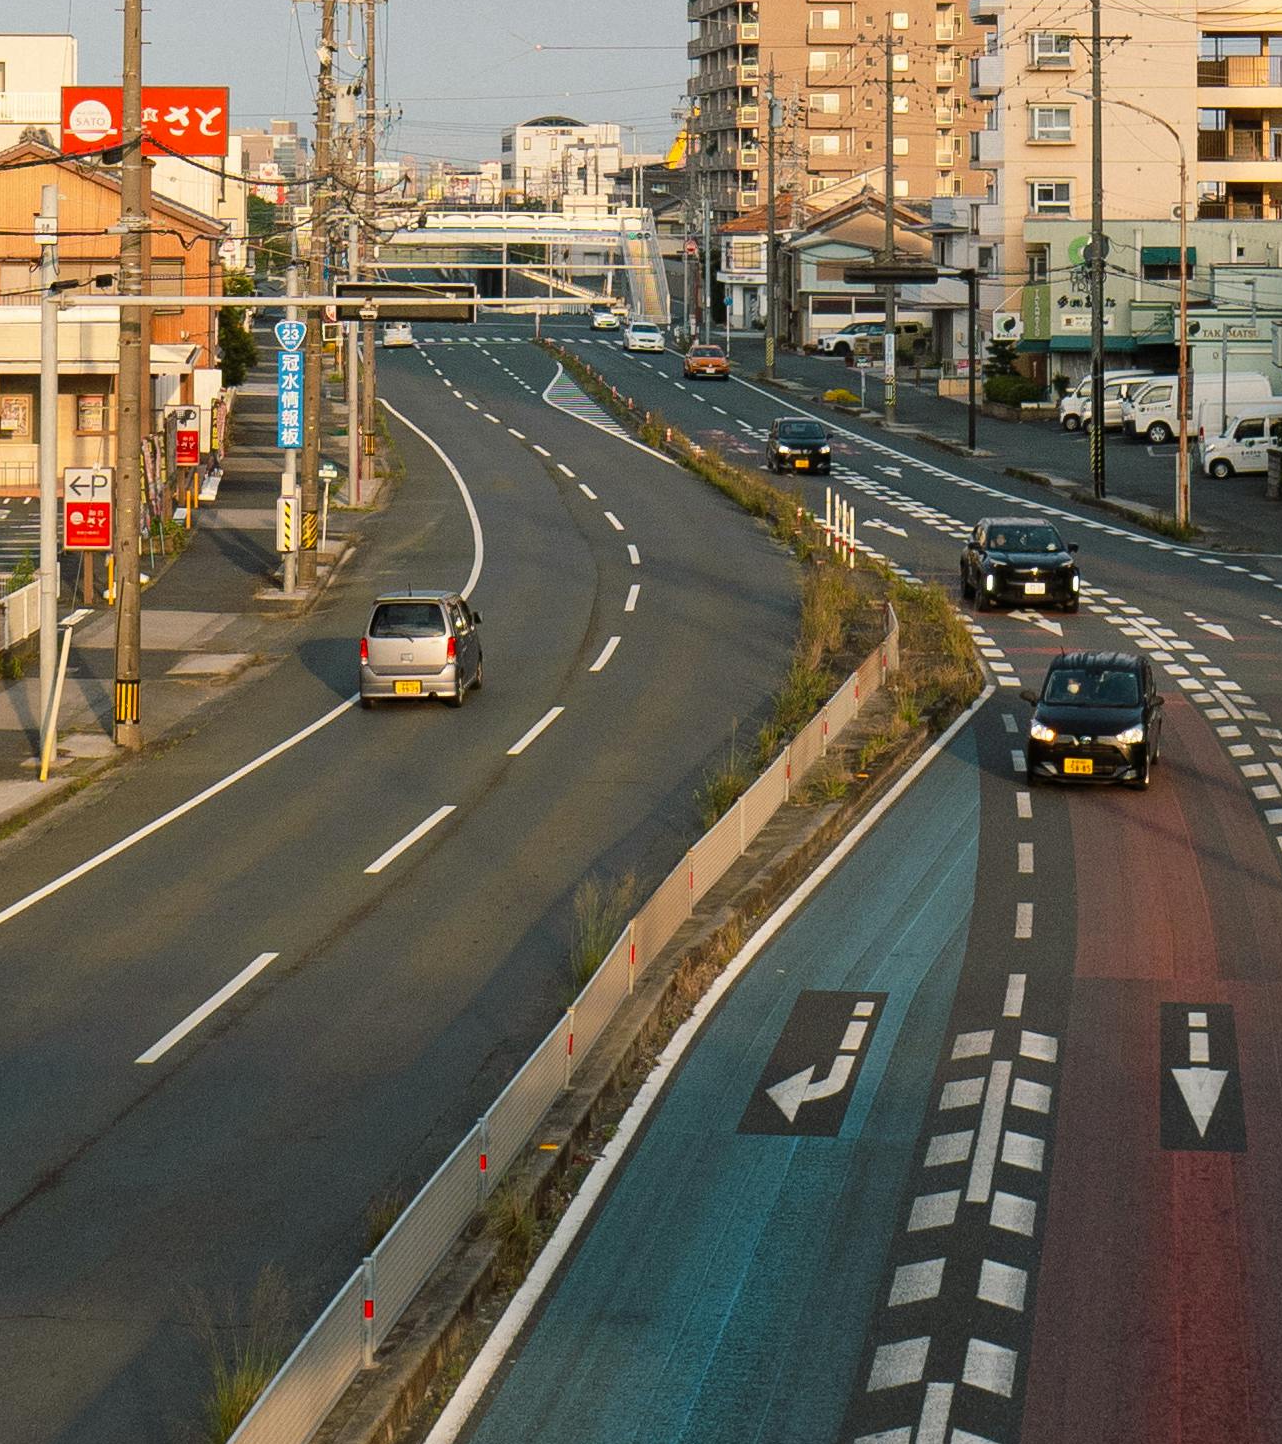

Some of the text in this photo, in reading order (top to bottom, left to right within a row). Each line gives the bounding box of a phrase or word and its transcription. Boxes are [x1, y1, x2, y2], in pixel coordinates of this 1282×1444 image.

[76, 117, 106, 127] SATO
[282, 329, 300, 341] 23
[281, 354, 300, 446] 冠水情報板
[91, 474, 108, 497] P
